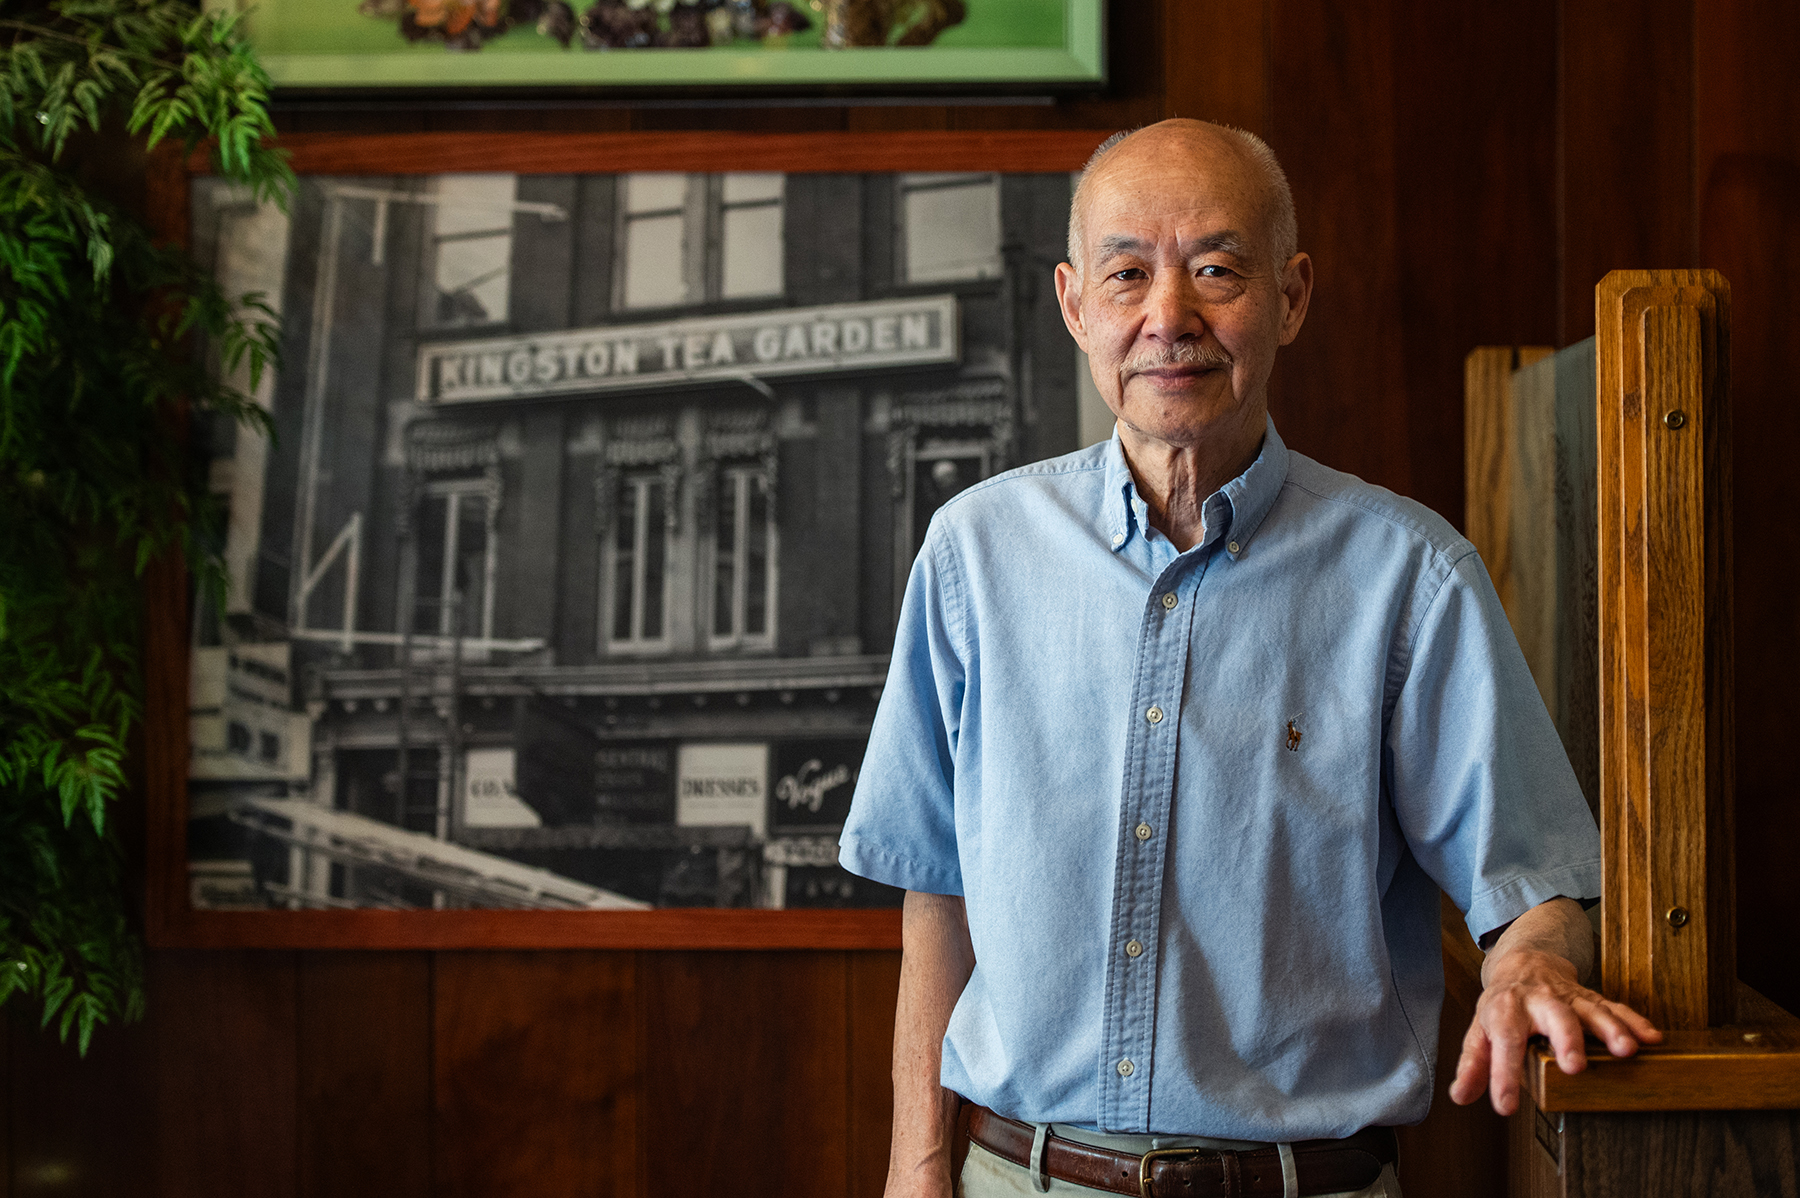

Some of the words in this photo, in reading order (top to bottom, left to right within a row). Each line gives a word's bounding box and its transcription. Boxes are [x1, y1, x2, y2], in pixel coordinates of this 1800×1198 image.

[440, 339, 639, 388] KINGSTON
[661, 332, 736, 369] TEA
[754, 313, 929, 362] GARDEN
[776, 758, 850, 812] Vogue
